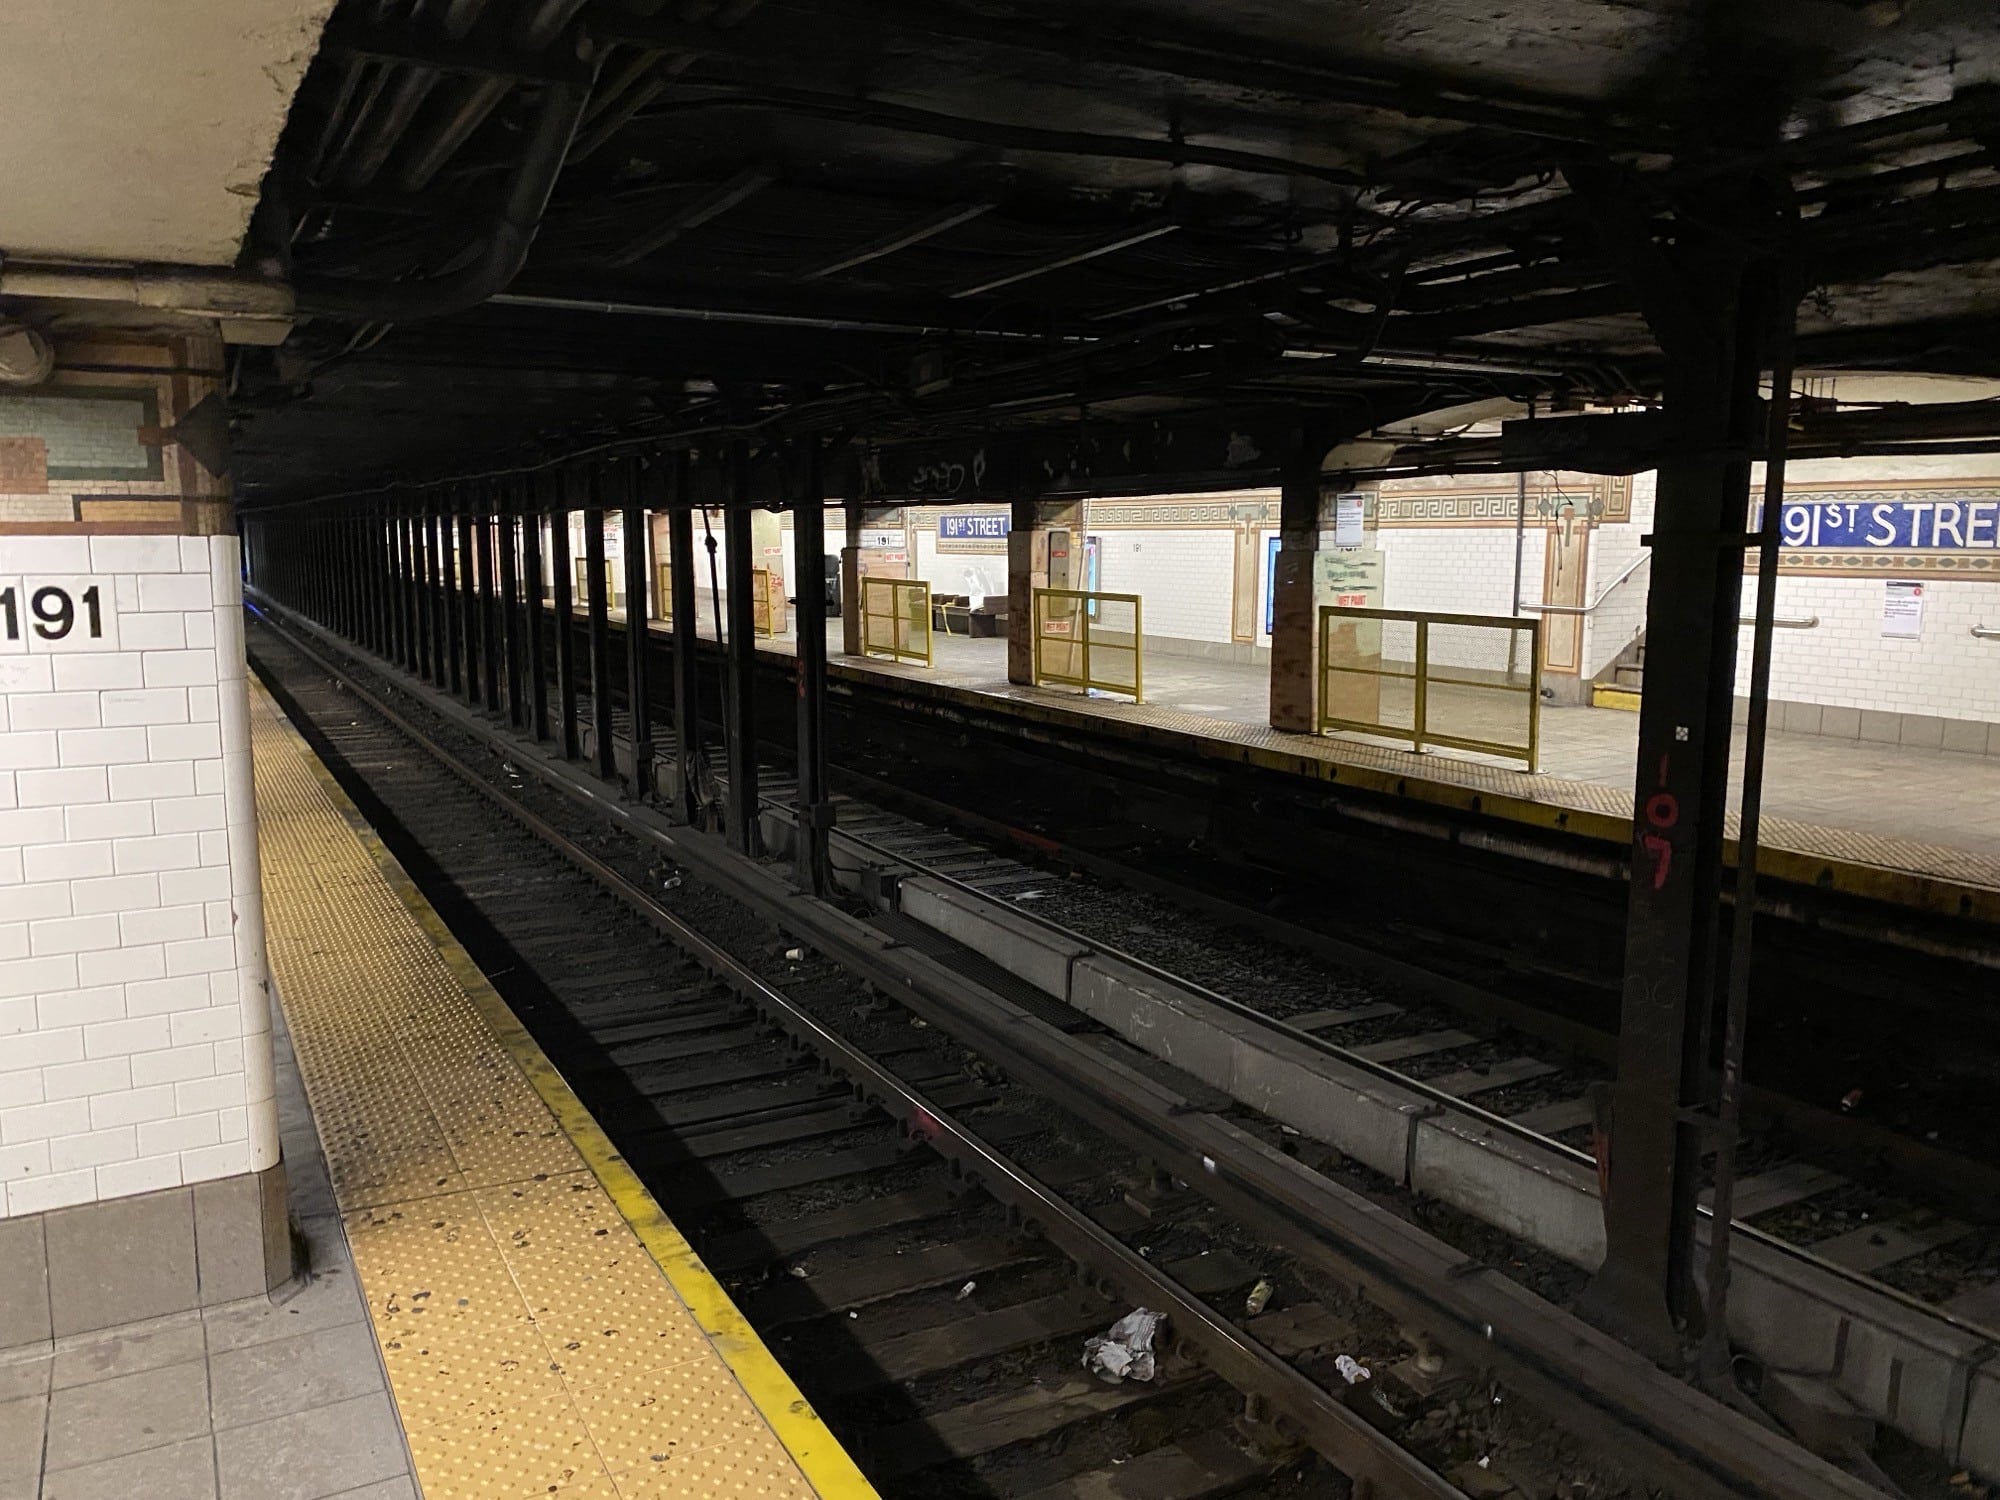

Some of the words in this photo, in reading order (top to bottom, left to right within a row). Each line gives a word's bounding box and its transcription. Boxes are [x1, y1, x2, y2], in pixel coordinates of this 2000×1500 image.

[877, 536, 890, 546] 191
[1783, 499, 1860, 548] 91ST
[1865, 502, 2000, 548] STRE
[0, 586, 102, 640] 191
